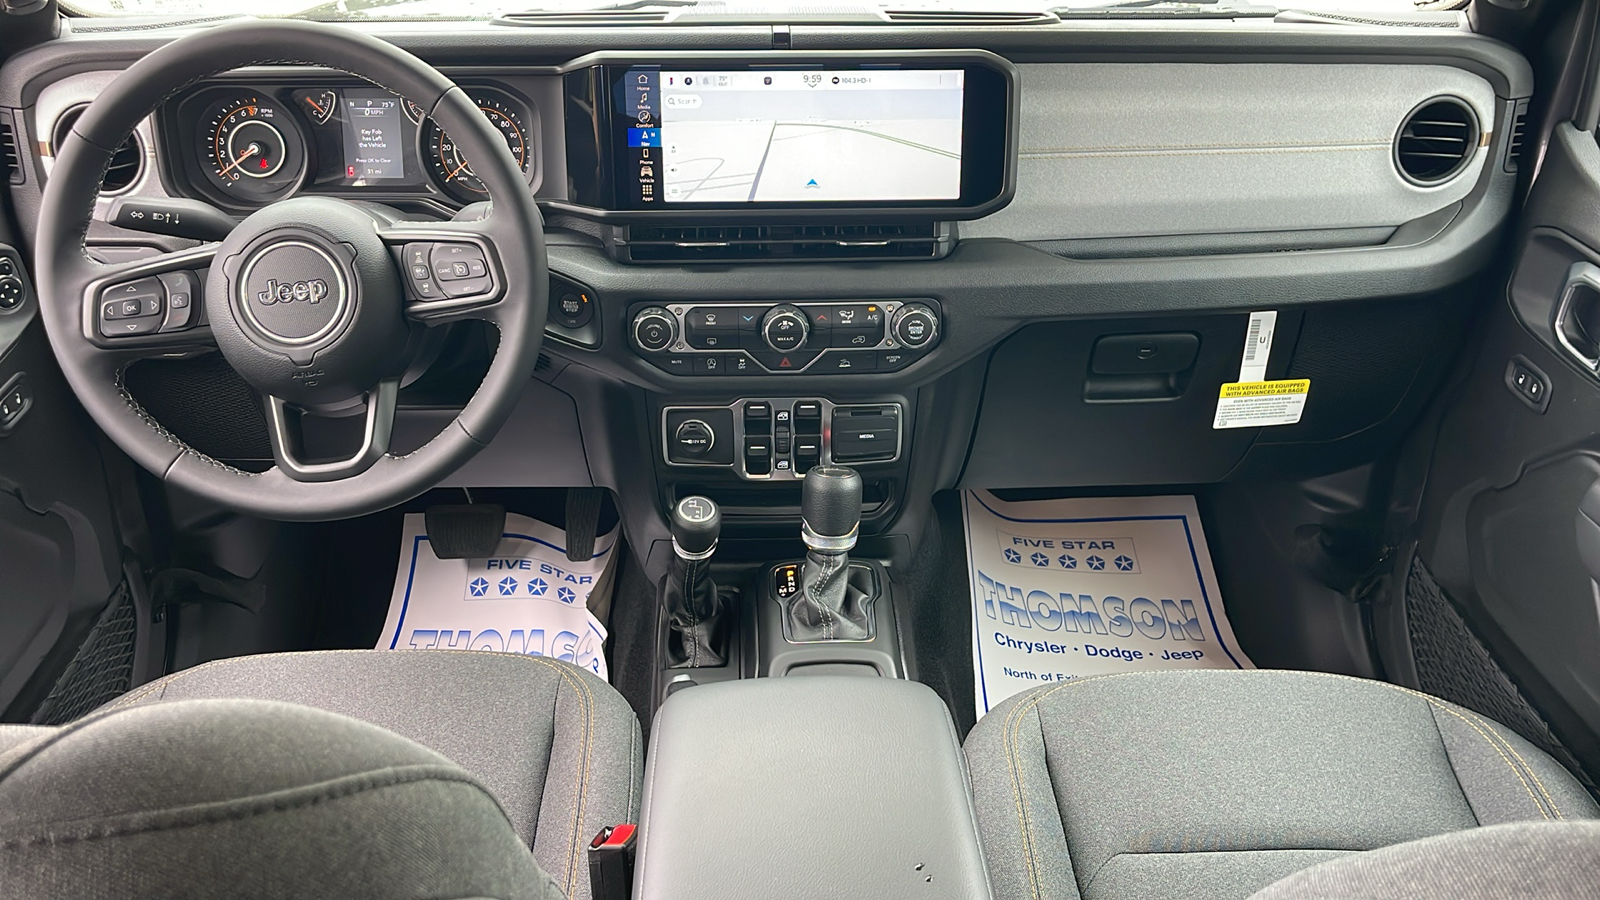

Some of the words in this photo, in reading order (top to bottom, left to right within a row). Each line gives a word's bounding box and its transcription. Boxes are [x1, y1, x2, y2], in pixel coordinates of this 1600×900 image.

[803, 74, 822, 83] 9:59
[364, 108, 370, 116] 0
[220, 150, 226, 158] 2
[258, 278, 328, 306] Jeep
[1012, 536, 1055, 549] FIVE
[1061, 540, 1116, 550] STAR
[487, 559, 532, 571] FIVE
[539, 563, 593, 586] STAR
[978, 569, 1206, 642] THOMSON
[994, 632, 1068, 655] Chrysler
[1085, 644, 1144, 662] Dodge
[1161, 649, 1204, 661] Jeep
[1003, 666, 1038, 681] North
[1040, 672, 1053, 681] of
